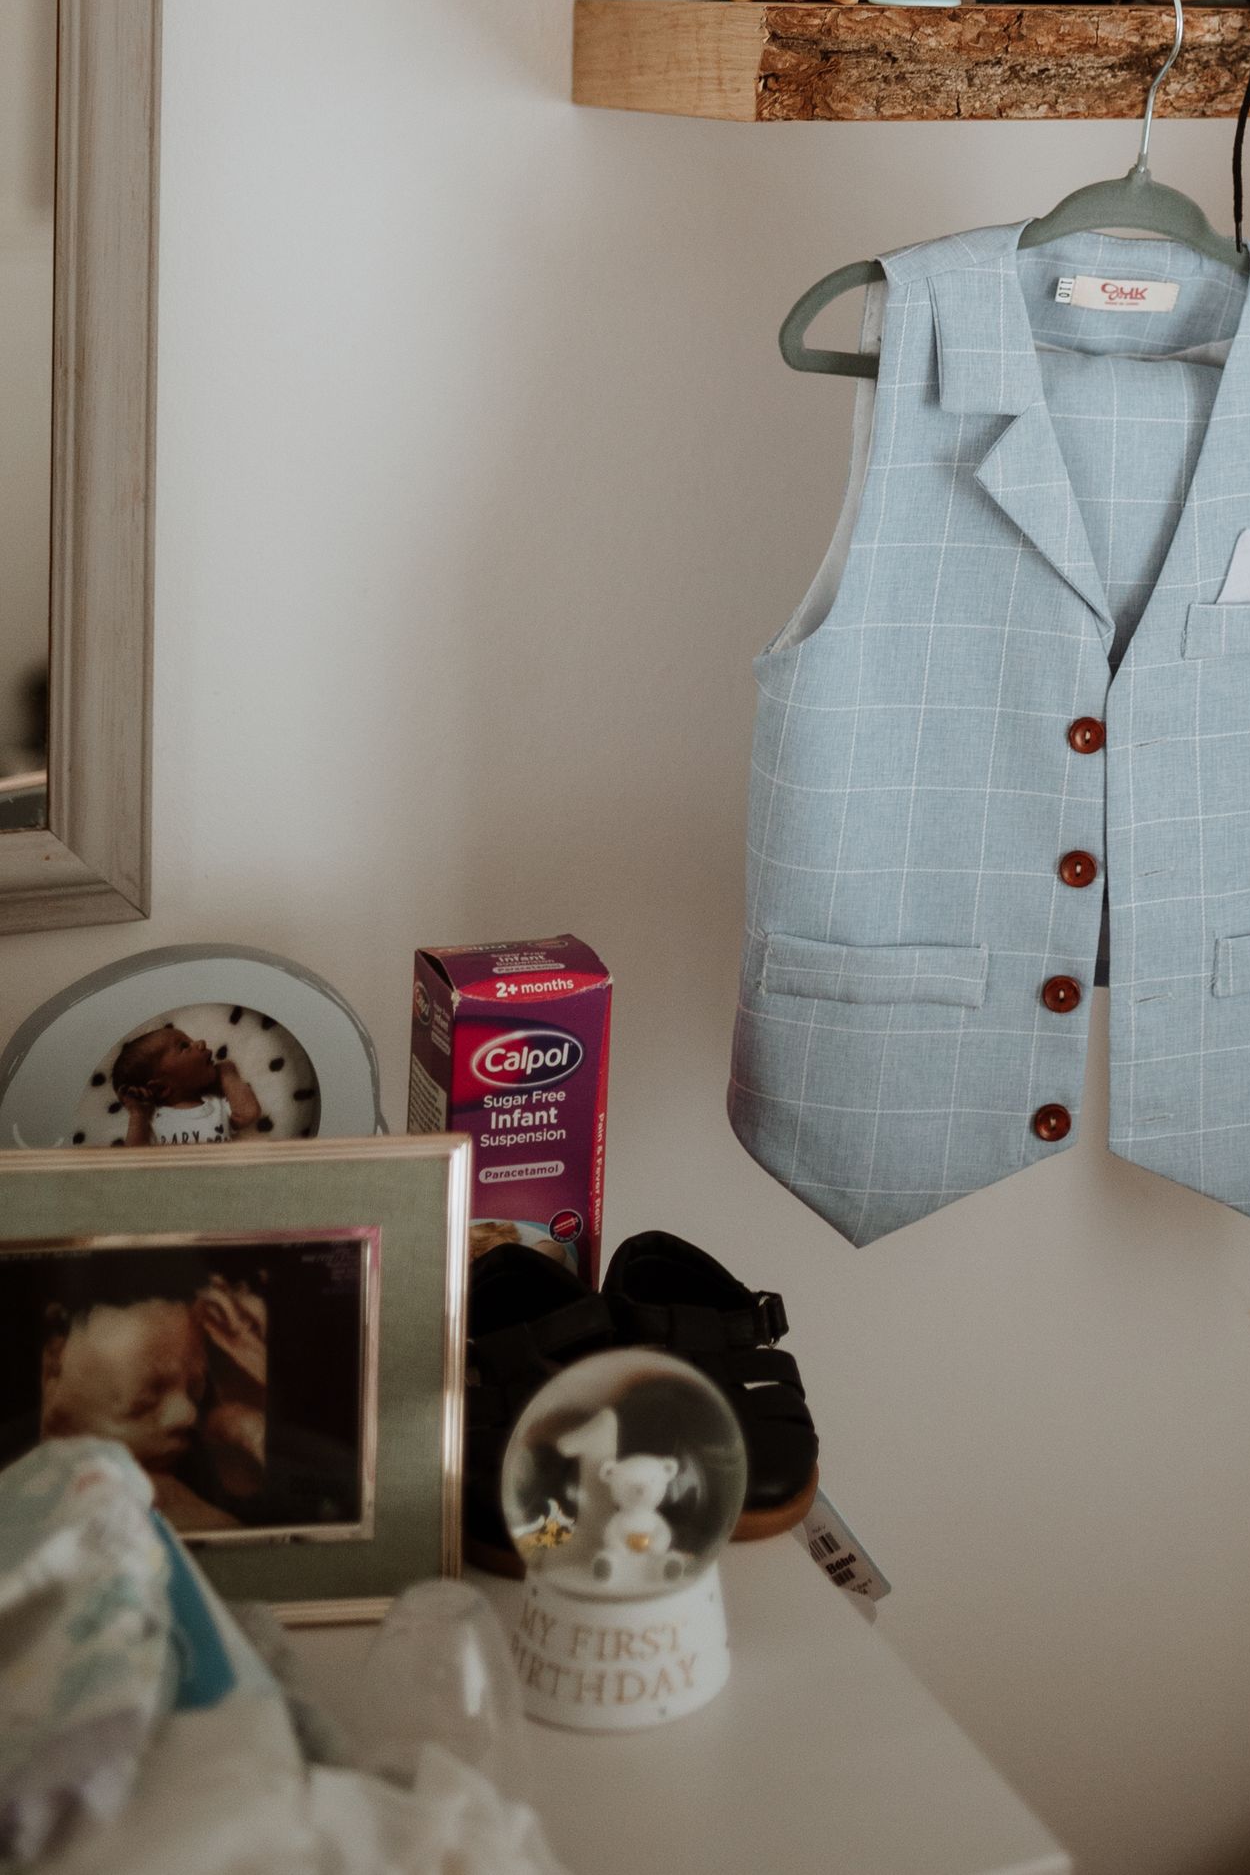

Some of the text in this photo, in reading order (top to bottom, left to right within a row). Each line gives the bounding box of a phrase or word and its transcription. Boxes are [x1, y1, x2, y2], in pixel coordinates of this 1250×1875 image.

[495, 978, 574, 998] 2+ months
[485, 1042, 569, 1075] Calpol
[483, 1090, 566, 1109] Sugar Free
[490, 1106, 558, 1130] Infant
[597, 1112, 605, 1143] Pain
[480, 1128, 566, 1147] Suspension
[485, 1164, 559, 1180] Paracetamol
[594, 1157, 602, 1195] Fever
[568, 1622, 687, 1662] FIRST
